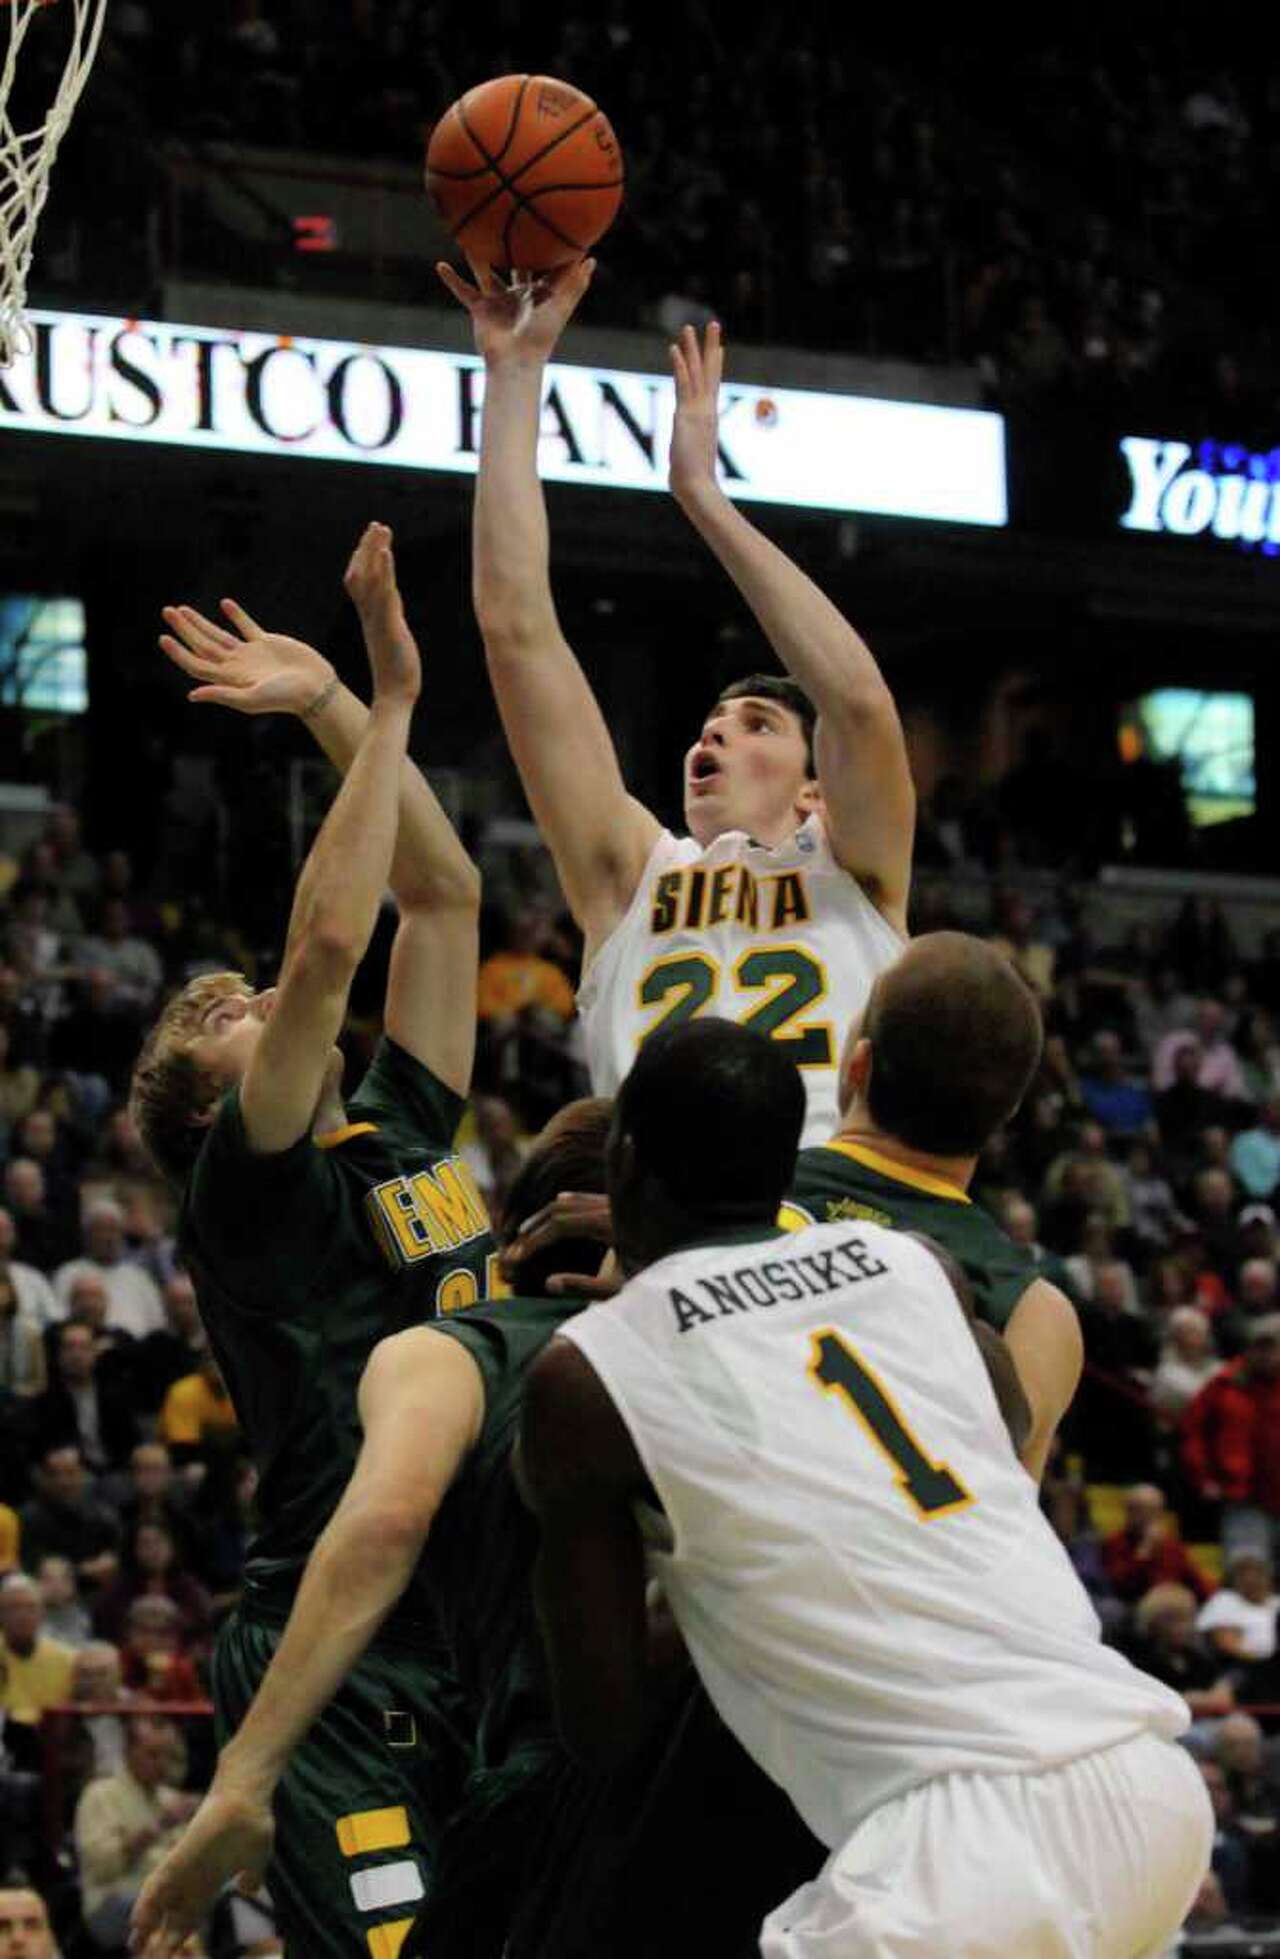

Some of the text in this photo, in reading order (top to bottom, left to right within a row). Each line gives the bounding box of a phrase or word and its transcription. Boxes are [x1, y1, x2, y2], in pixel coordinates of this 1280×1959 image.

[1119, 435, 1280, 544] You
[652, 863, 811, 936] SIENA
[635, 941, 838, 1072] 22
[668, 1238, 889, 1334] ANOSIKE
[805, 1326, 978, 1523] 1
